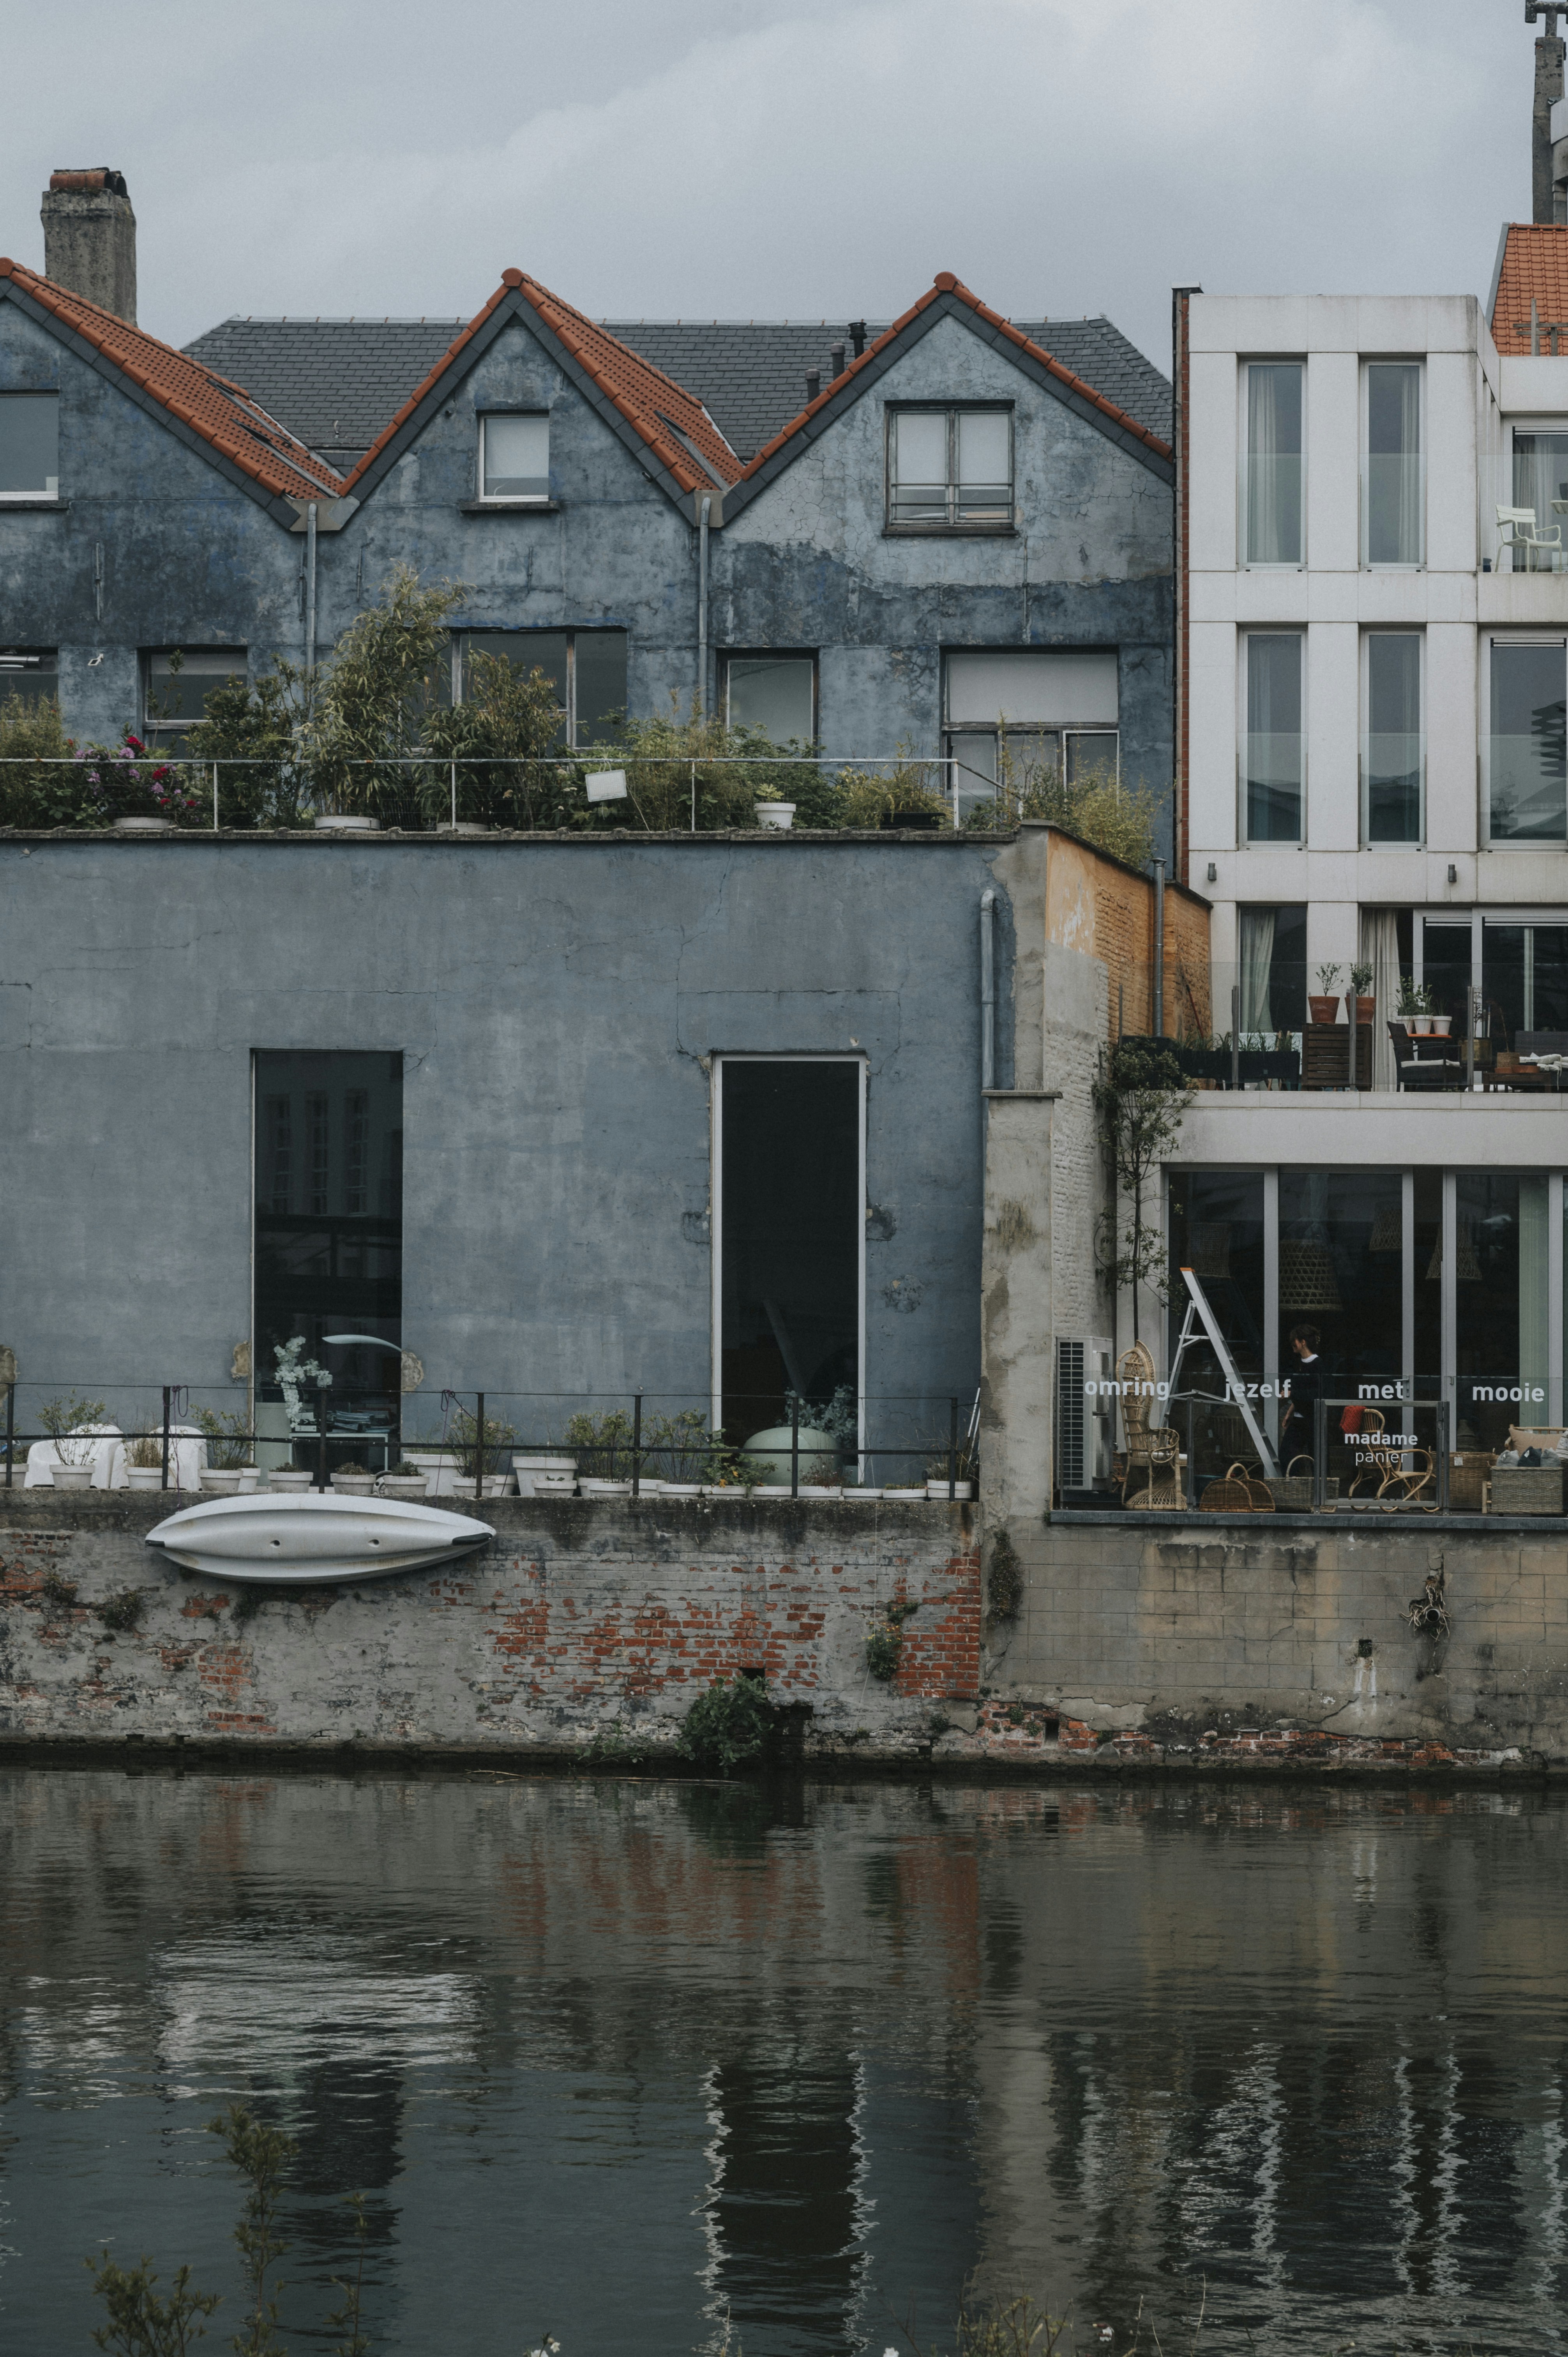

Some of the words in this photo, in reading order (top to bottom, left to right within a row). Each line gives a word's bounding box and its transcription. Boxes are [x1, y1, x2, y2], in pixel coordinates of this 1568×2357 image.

[1084, 1376, 1169, 1401] omring
[1224, 1378, 1291, 1402] jezelf
[1358, 1382, 1404, 1399] met
[1473, 1383, 1545, 1402] mooie
[1345, 1431, 1418, 1445] madame
[1355, 1449, 1408, 1466] panier
